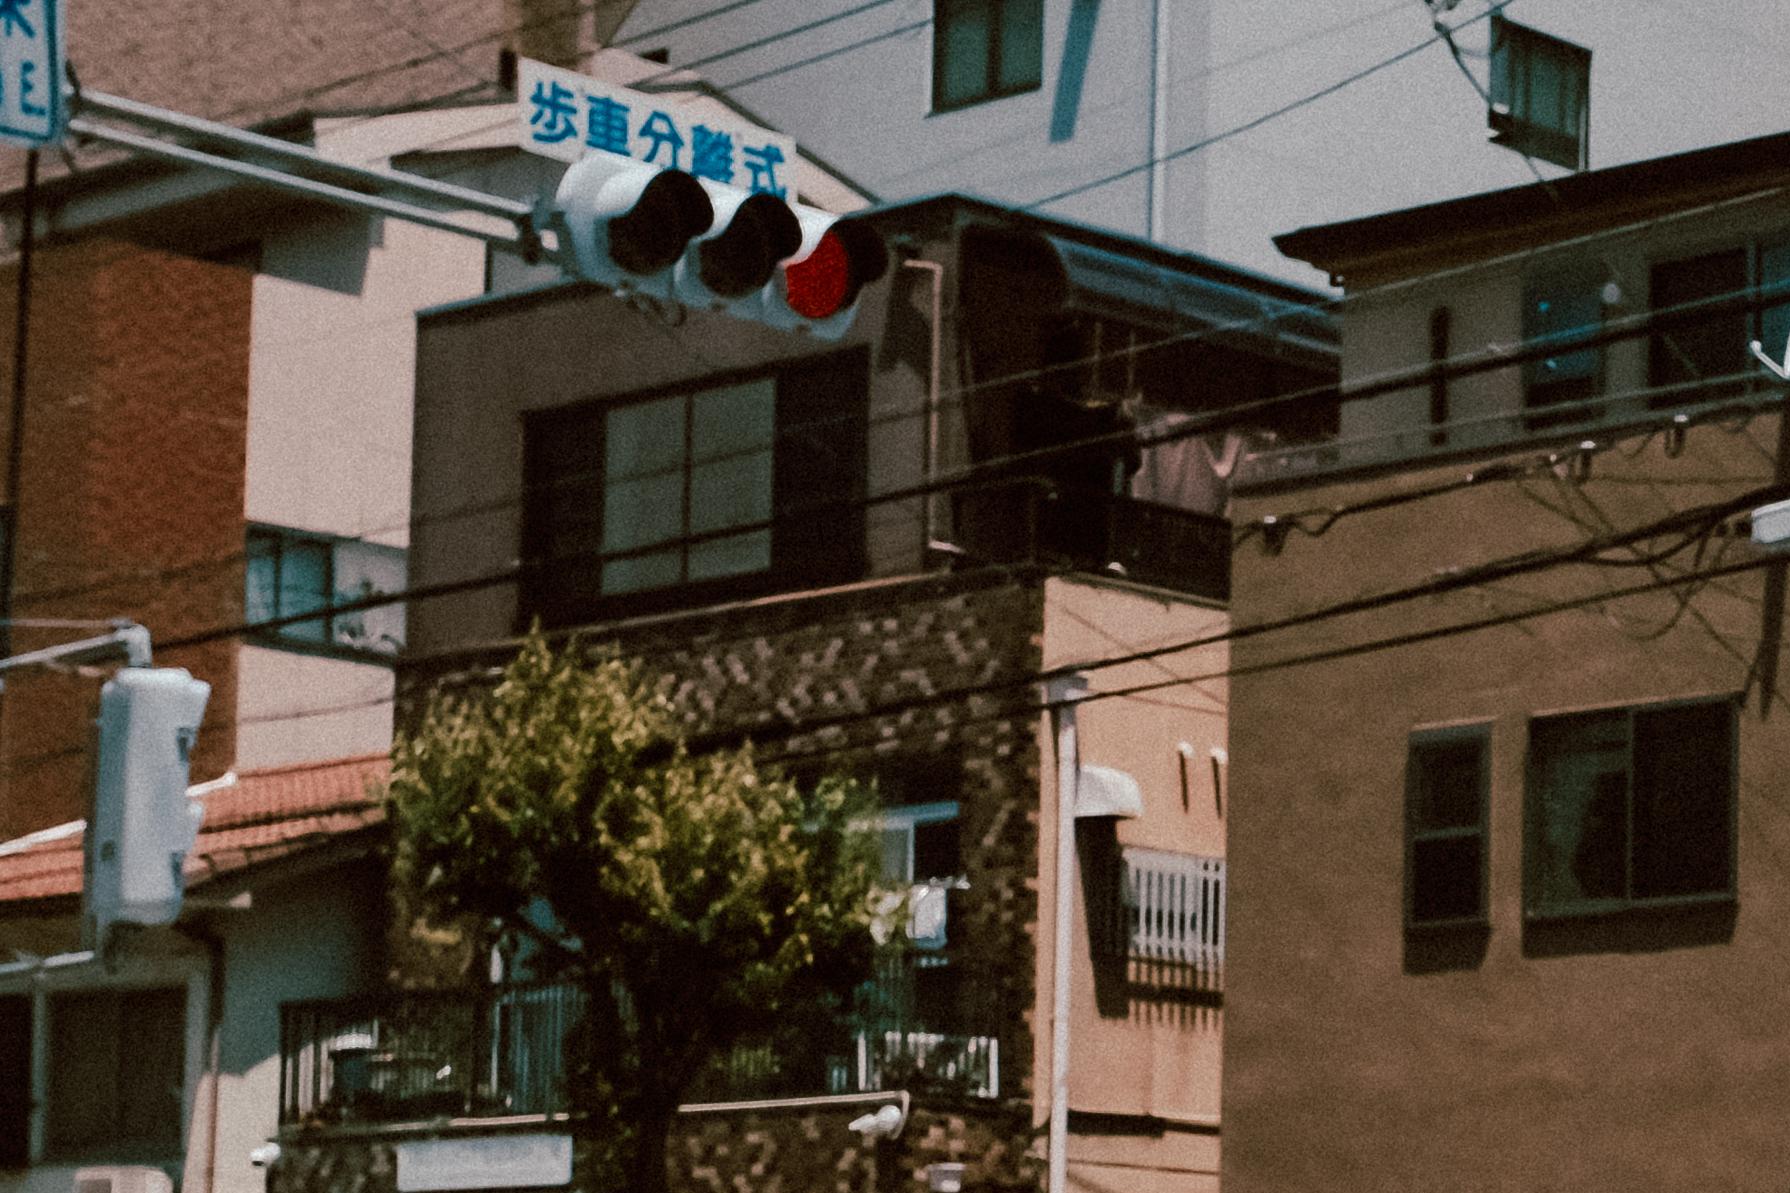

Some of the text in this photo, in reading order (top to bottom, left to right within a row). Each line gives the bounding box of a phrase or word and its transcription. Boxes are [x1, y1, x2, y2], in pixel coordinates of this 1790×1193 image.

[529, 80, 787, 202] 歩車分離式
